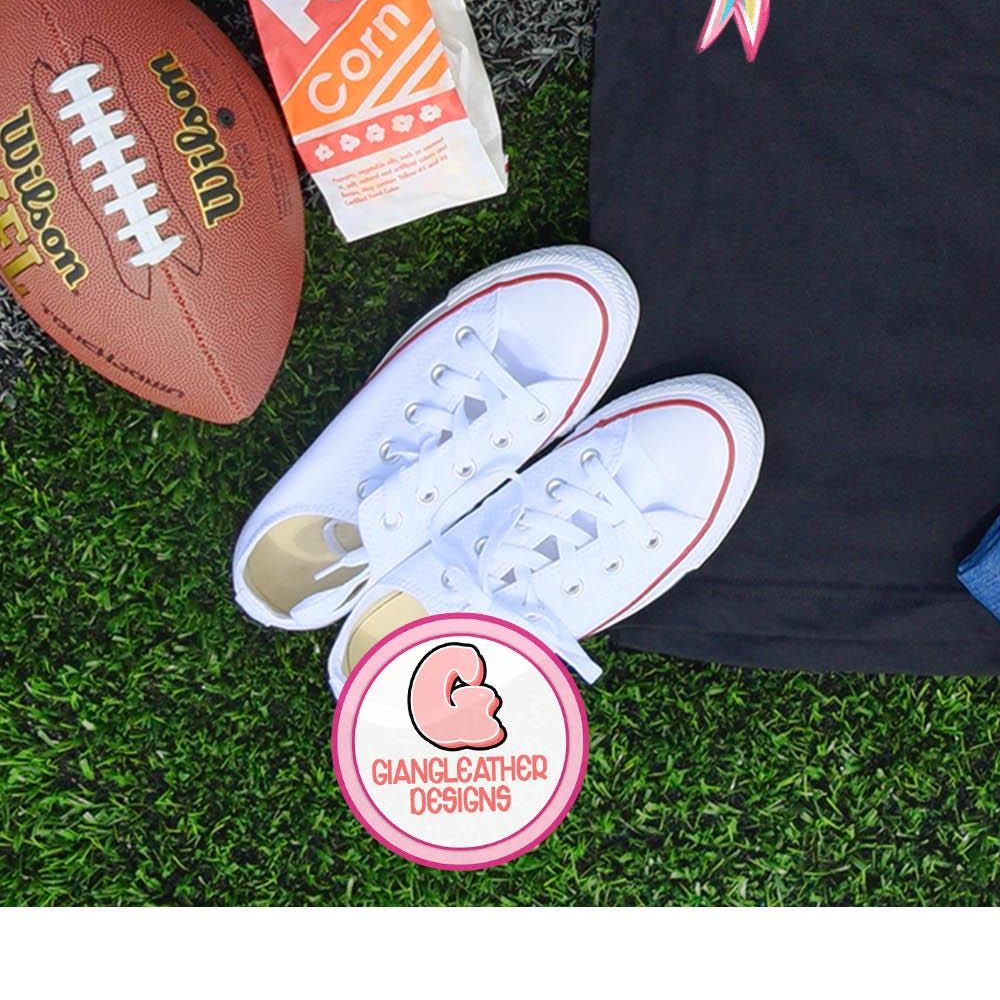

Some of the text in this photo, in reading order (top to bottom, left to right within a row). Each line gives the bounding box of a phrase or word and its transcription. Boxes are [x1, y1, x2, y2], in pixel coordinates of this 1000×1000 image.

[307, 3, 411, 114] Corn
[0, 105, 89, 290] Wilson
[149, 50, 243, 229] Wilson
[0, 178, 44, 298] FL
